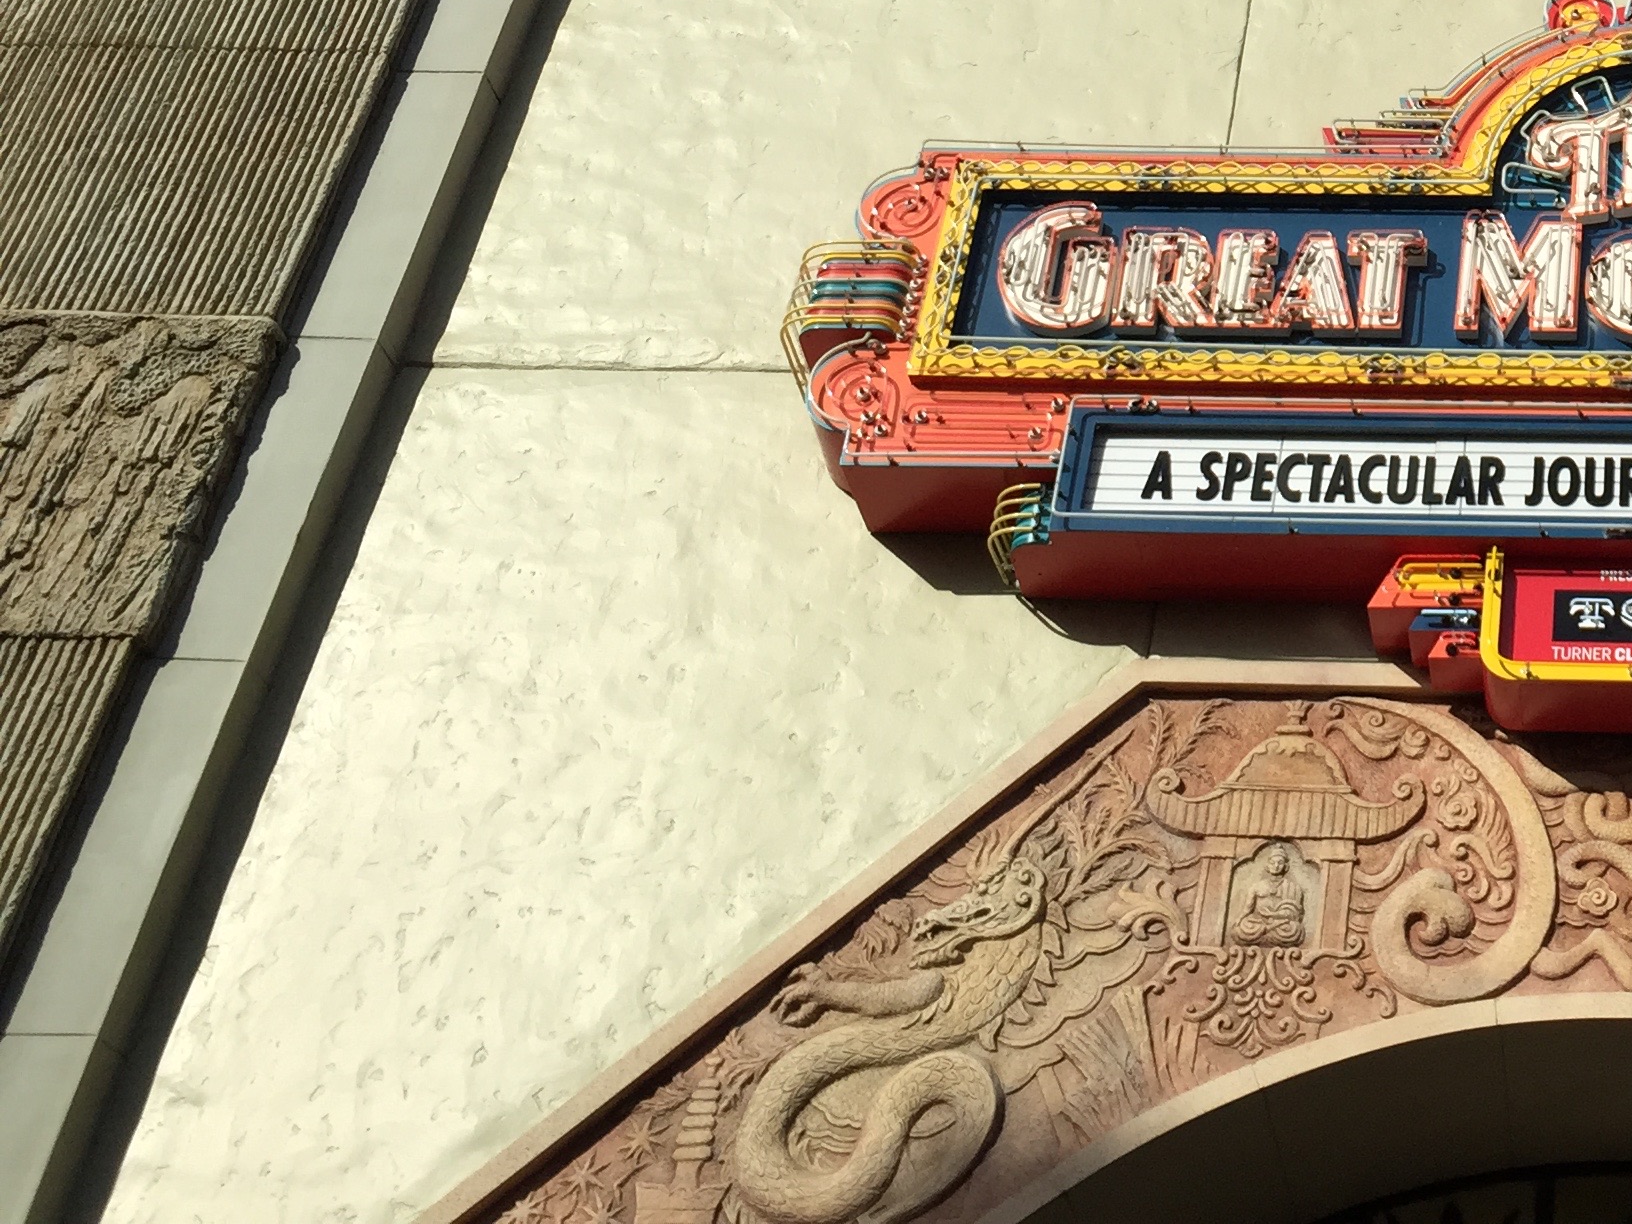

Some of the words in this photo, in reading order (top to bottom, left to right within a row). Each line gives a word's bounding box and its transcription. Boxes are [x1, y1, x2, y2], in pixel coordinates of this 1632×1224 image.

[998, 201, 1428, 338] GREAT
[1141, 450, 1172, 500] A
[1196, 451, 1505, 506] SPECTACULAR
[1552, 646, 1611, 660] TURNER
